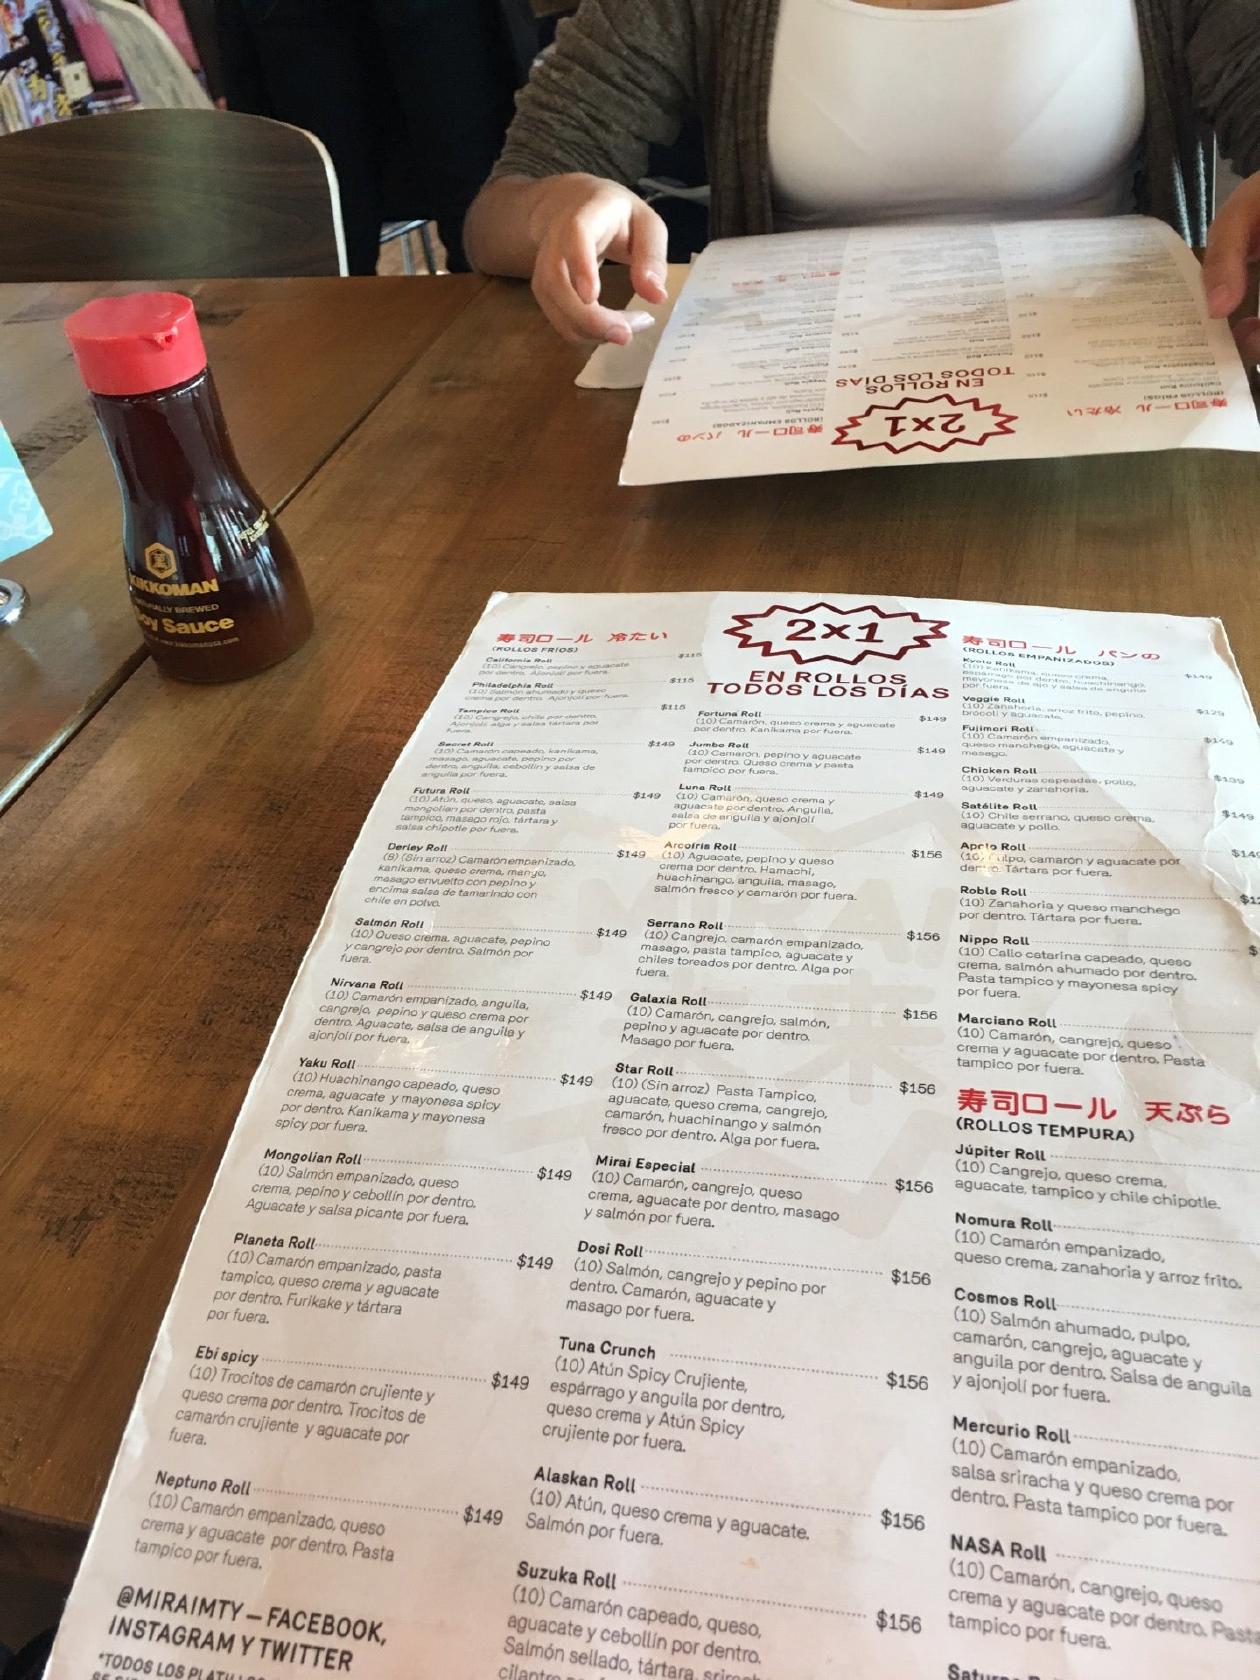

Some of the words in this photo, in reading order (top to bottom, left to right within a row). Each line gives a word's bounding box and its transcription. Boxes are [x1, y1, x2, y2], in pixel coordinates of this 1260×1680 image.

[893, 371, 938, 383] LOS
[941, 366, 1015, 379] TODOS
[866, 379, 949, 394] ROLLOS
[957, 378, 984, 388] EN
[175, 603, 219, 613] BREWED
[162, 617, 234, 634] Sauce
[785, 618, 884, 643] 2x1
[607, 632, 667, 642] 冷たい
[995, 660, 1015, 668] Roll
[472, 681, 532, 689] Philadelphia
[749, 670, 785, 682] EN
[794, 671, 906, 685] ROLLOS
[707, 682, 802, 696] TODOS
[813, 684, 867, 697] LOS
[877, 684, 949, 699] DÍAS
[1003, 696, 1025, 704] Roll
[740, 710, 761, 718] Roll
[648, 740, 675, 748] $149
[961, 766, 1010, 774] Chicken
[709, 784, 731, 792] Roll
[914, 790, 944, 799] $149
[961, 801, 1009, 810] Satélite
[468, 826, 488, 834] por
[489, 825, 519, 834] fuera.
[425, 843, 448, 852] Roll
[713, 842, 737, 851] Roll
[960, 885, 997, 895] Roble
[1001, 887, 1027, 896] Roll
[354, 917, 397, 928] Salmón
[400, 919, 424, 928] Roll
[646, 918, 695, 928] Serrano
[698, 920, 723, 930] Roll
[959, 934, 998, 946] Nippo
[1002, 935, 1030, 946] Roll
[330, 977, 376, 989] Nirvana
[379, 980, 404, 990] Roll
[630, 992, 677, 1005] Galaxia
[681, 995, 706, 1006] Roll
[958, 1012, 1024, 1026] Marciano
[1028, 1017, 1057, 1028] Roll
[299, 1057, 327, 1068] Yaku
[330, 1058, 356, 1069] Roll
[560, 1073, 593, 1087] $149
[615, 1062, 644, 1074] Star
[647, 1064, 673, 1076] Roll
[1144, 1101, 1230, 1125] 天ぷら
[1037, 1123, 1134, 1143] TEMPURA)
[263, 1148, 332, 1164] Mongolian
[335, 1152, 362, 1165] Roll
[955, 1144, 1010, 1158] Júpiter
[1015, 1148, 1046, 1161] Roll
[595, 1154, 632, 1168] Mirai
[635, 1158, 695, 1173] Especial
[954, 1179, 1027, 1195] aguacate,
[1031, 1183, 1094, 1200] tampico
[1097, 1191, 1106, 1203] y
[1110, 1189, 1149, 1204] chile
[1152, 1193, 1221, 1209] chipotle.
[955, 1212, 1016, 1229] Nomura
[1020, 1216, 1053, 1232] Roll
[233, 1232, 284, 1248] Planeta
[288, 1235, 316, 1250] Roll
[577, 1240, 610, 1255] Dosi
[614, 1243, 643, 1258] Roll
[212, 1290, 237, 1303] por
[238, 1290, 283, 1306] dentro.
[286, 1292, 342, 1310] Furikake
[343, 1301, 354, 1314] y
[356, 1299, 402, 1315] tártara
[954, 1287, 1018, 1306] Cosmos
[1024, 1294, 1057, 1311] Roll
[195, 1345, 219, 1360] Ebi
[220, 1349, 259, 1367] spicy
[559, 1336, 595, 1353] Tuna
[600, 1340, 656, 1359] Crunch
[886, 1370, 928, 1391] $156
[189, 1364, 218, 1382] (10)
[221, 1367, 274, 1387] Trocitos
[276, 1374, 294, 1389] de
[296, 1379, 356, 1395] camarón
[359, 1383, 423, 1402] crujiente
[424, 1391, 436, 1406] y
[550, 1381, 625, 1403] espárrago
[627, 1390, 638, 1404] y
[640, 1390, 698, 1409] anguila
[702, 1397, 729, 1412] por
[731, 1398, 785, 1420] dentro,
[953, 1415, 1030, 1439] Mercurio
[1036, 1425, 1071, 1444] Roll
[534, 1466, 598, 1488] Alaskan
[603, 1474, 635, 1494] Roll
[155, 1470, 217, 1492] Neptuno
[220, 1478, 251, 1496] Roll
[463, 1504, 503, 1526] $149
[950, 1534, 1005, 1557] NASA
[1010, 1541, 1046, 1562] Roll
[516, 1560, 578, 1585] Suzuka
[583, 1569, 616, 1590] Roll
[876, 1608, 922, 1634] $156
[116, 1585, 244, 1621] @MIRAIMTY
[266, 1606, 386, 1646] FACEBOOK,
[108, 1615, 235, 1654] INSTAGRAM
[241, 1634, 256, 1656] Y
[260, 1637, 353, 1672] TWITTER
